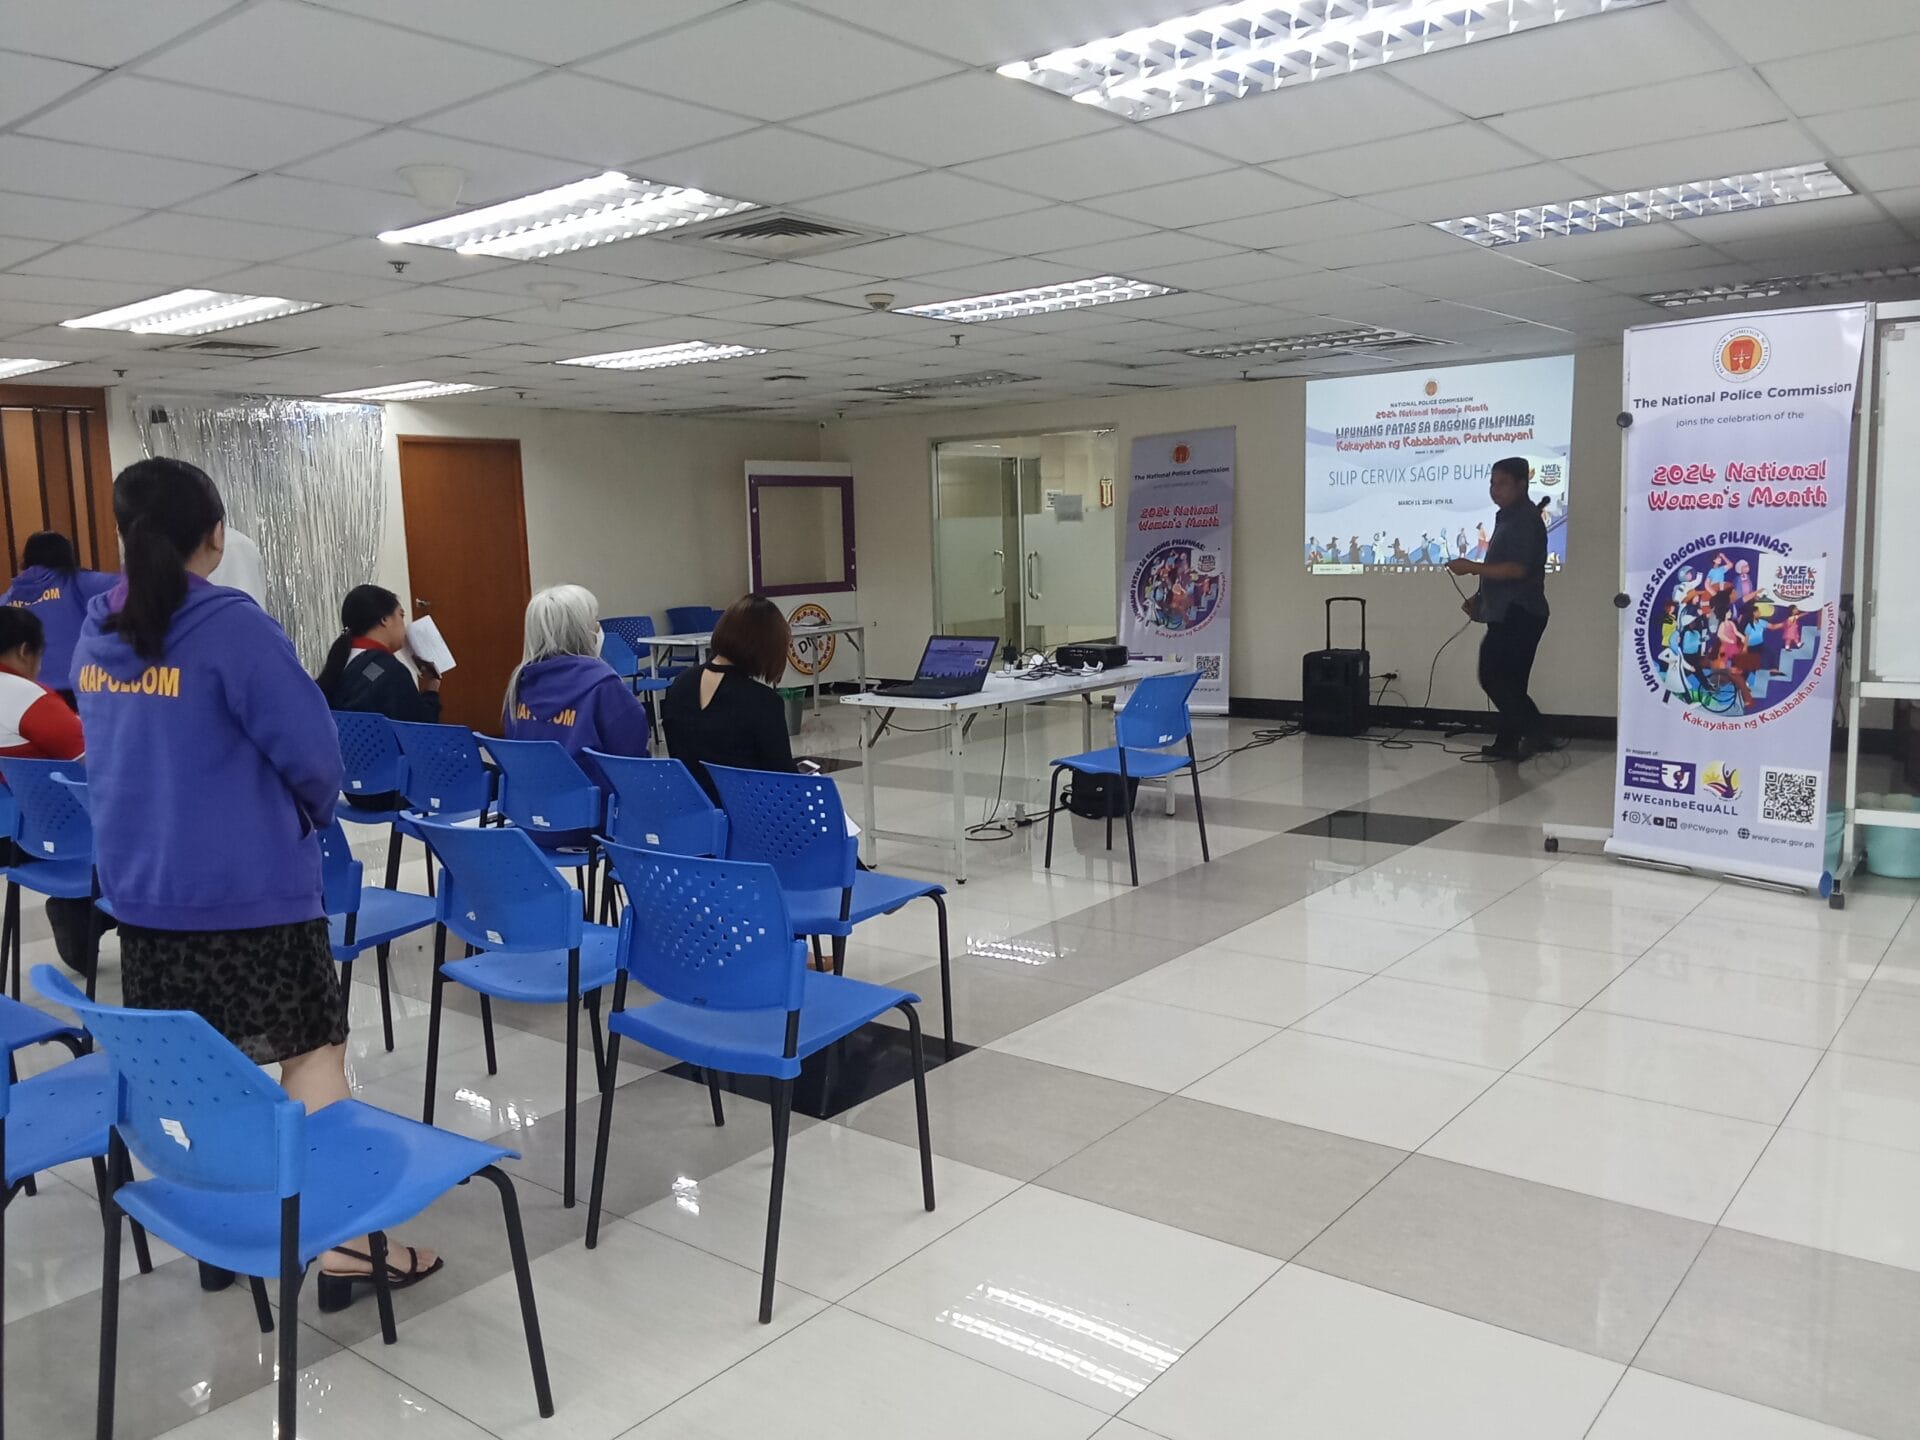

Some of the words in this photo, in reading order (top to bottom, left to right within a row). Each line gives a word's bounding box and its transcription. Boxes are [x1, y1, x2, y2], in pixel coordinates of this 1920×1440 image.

[1634, 398, 1657, 409] The
[1662, 392, 1715, 407] National
[1720, 388, 1762, 402] Police
[1767, 382, 1852, 398] Commission
[1336, 424, 1383, 438] LIPUNANG
[1385, 422, 1416, 436] PATAS
[1418, 420, 1431, 433] SA
[1433, 417, 1476, 432] BAGONG
[1676, 417, 1697, 428] joins
[1700, 416, 1714, 425] the
[1717, 412, 1771, 424] celebration
[1774, 410, 1786, 420] of
[1788, 410, 1805, 420] the
[1336, 440, 1386, 453] Kakayahan
[1388, 440, 1400, 450] ng
[1146, 471, 1171, 479] National
[1192, 466, 1230, 475] Commission
[1328, 469, 1357, 486] SILIP
[1361, 467, 1406, 485] CERVIX
[1410, 465, 1450, 482] SAGIP
[1453, 463, 1493, 481] BUHA
[1651, 463, 1716, 485] 2024
[1725, 460, 1828, 483] National
[1174, 503, 1219, 516] National
[1648, 486, 1741, 512] Women's
[1748, 485, 1828, 509] Month
[1185, 516, 1220, 529] Month
[1663, 534, 1716, 571] BAGONG
[1719, 531, 1793, 557] PILIPINAS:
[1651, 567, 1666, 585] SA
[1784, 565, 1807, 575] WE
[1635, 584, 1656, 625] PATAS
[1634, 627, 1660, 692] LIPUNANG
[1682, 711, 1741, 731] Kakayahan
[1744, 718, 1758, 729] ng
[1814, 601, 1837, 677] Patutunayan!
[1623, 792, 1739, 816] #WEcanbeEquALL
[1680, 822, 1729, 836] @PCWgovph
